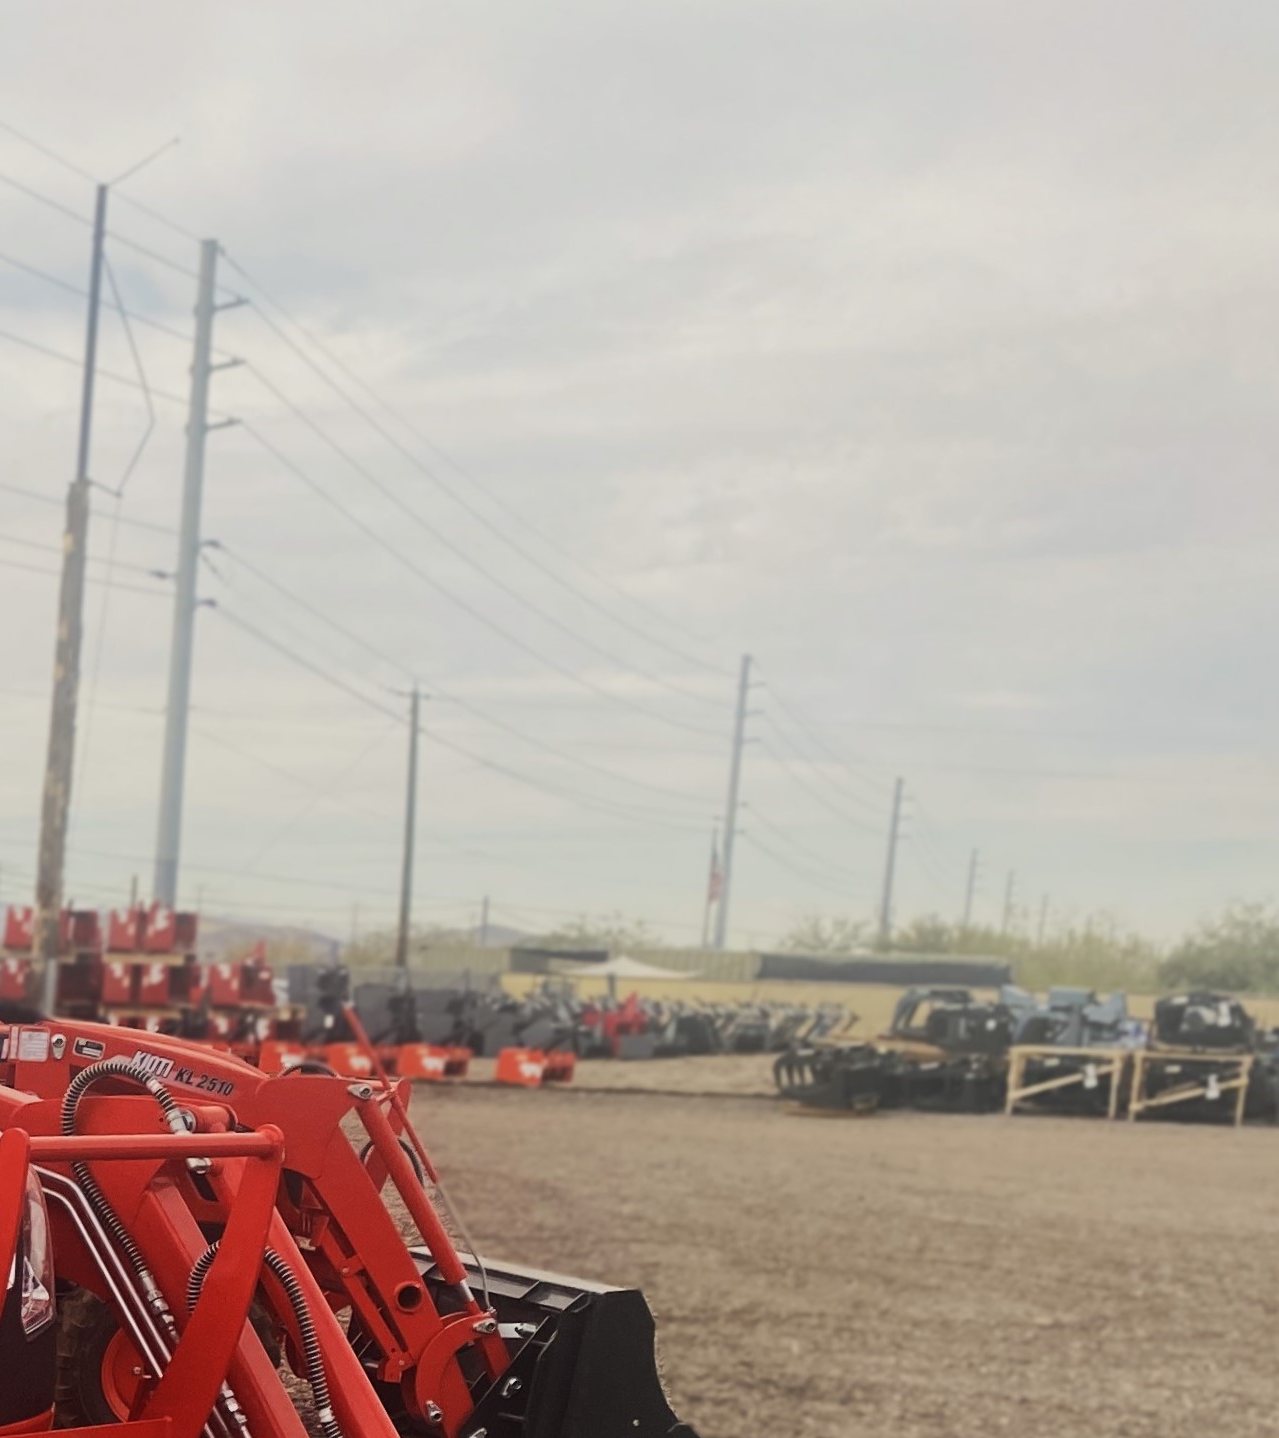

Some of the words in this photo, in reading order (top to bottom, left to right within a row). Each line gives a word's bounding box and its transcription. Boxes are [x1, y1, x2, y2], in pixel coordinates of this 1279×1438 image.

[131, 1050, 174, 1078] KIOTI
[174, 1067, 195, 1085] KL
[196, 1074, 234, 1096] 2510
